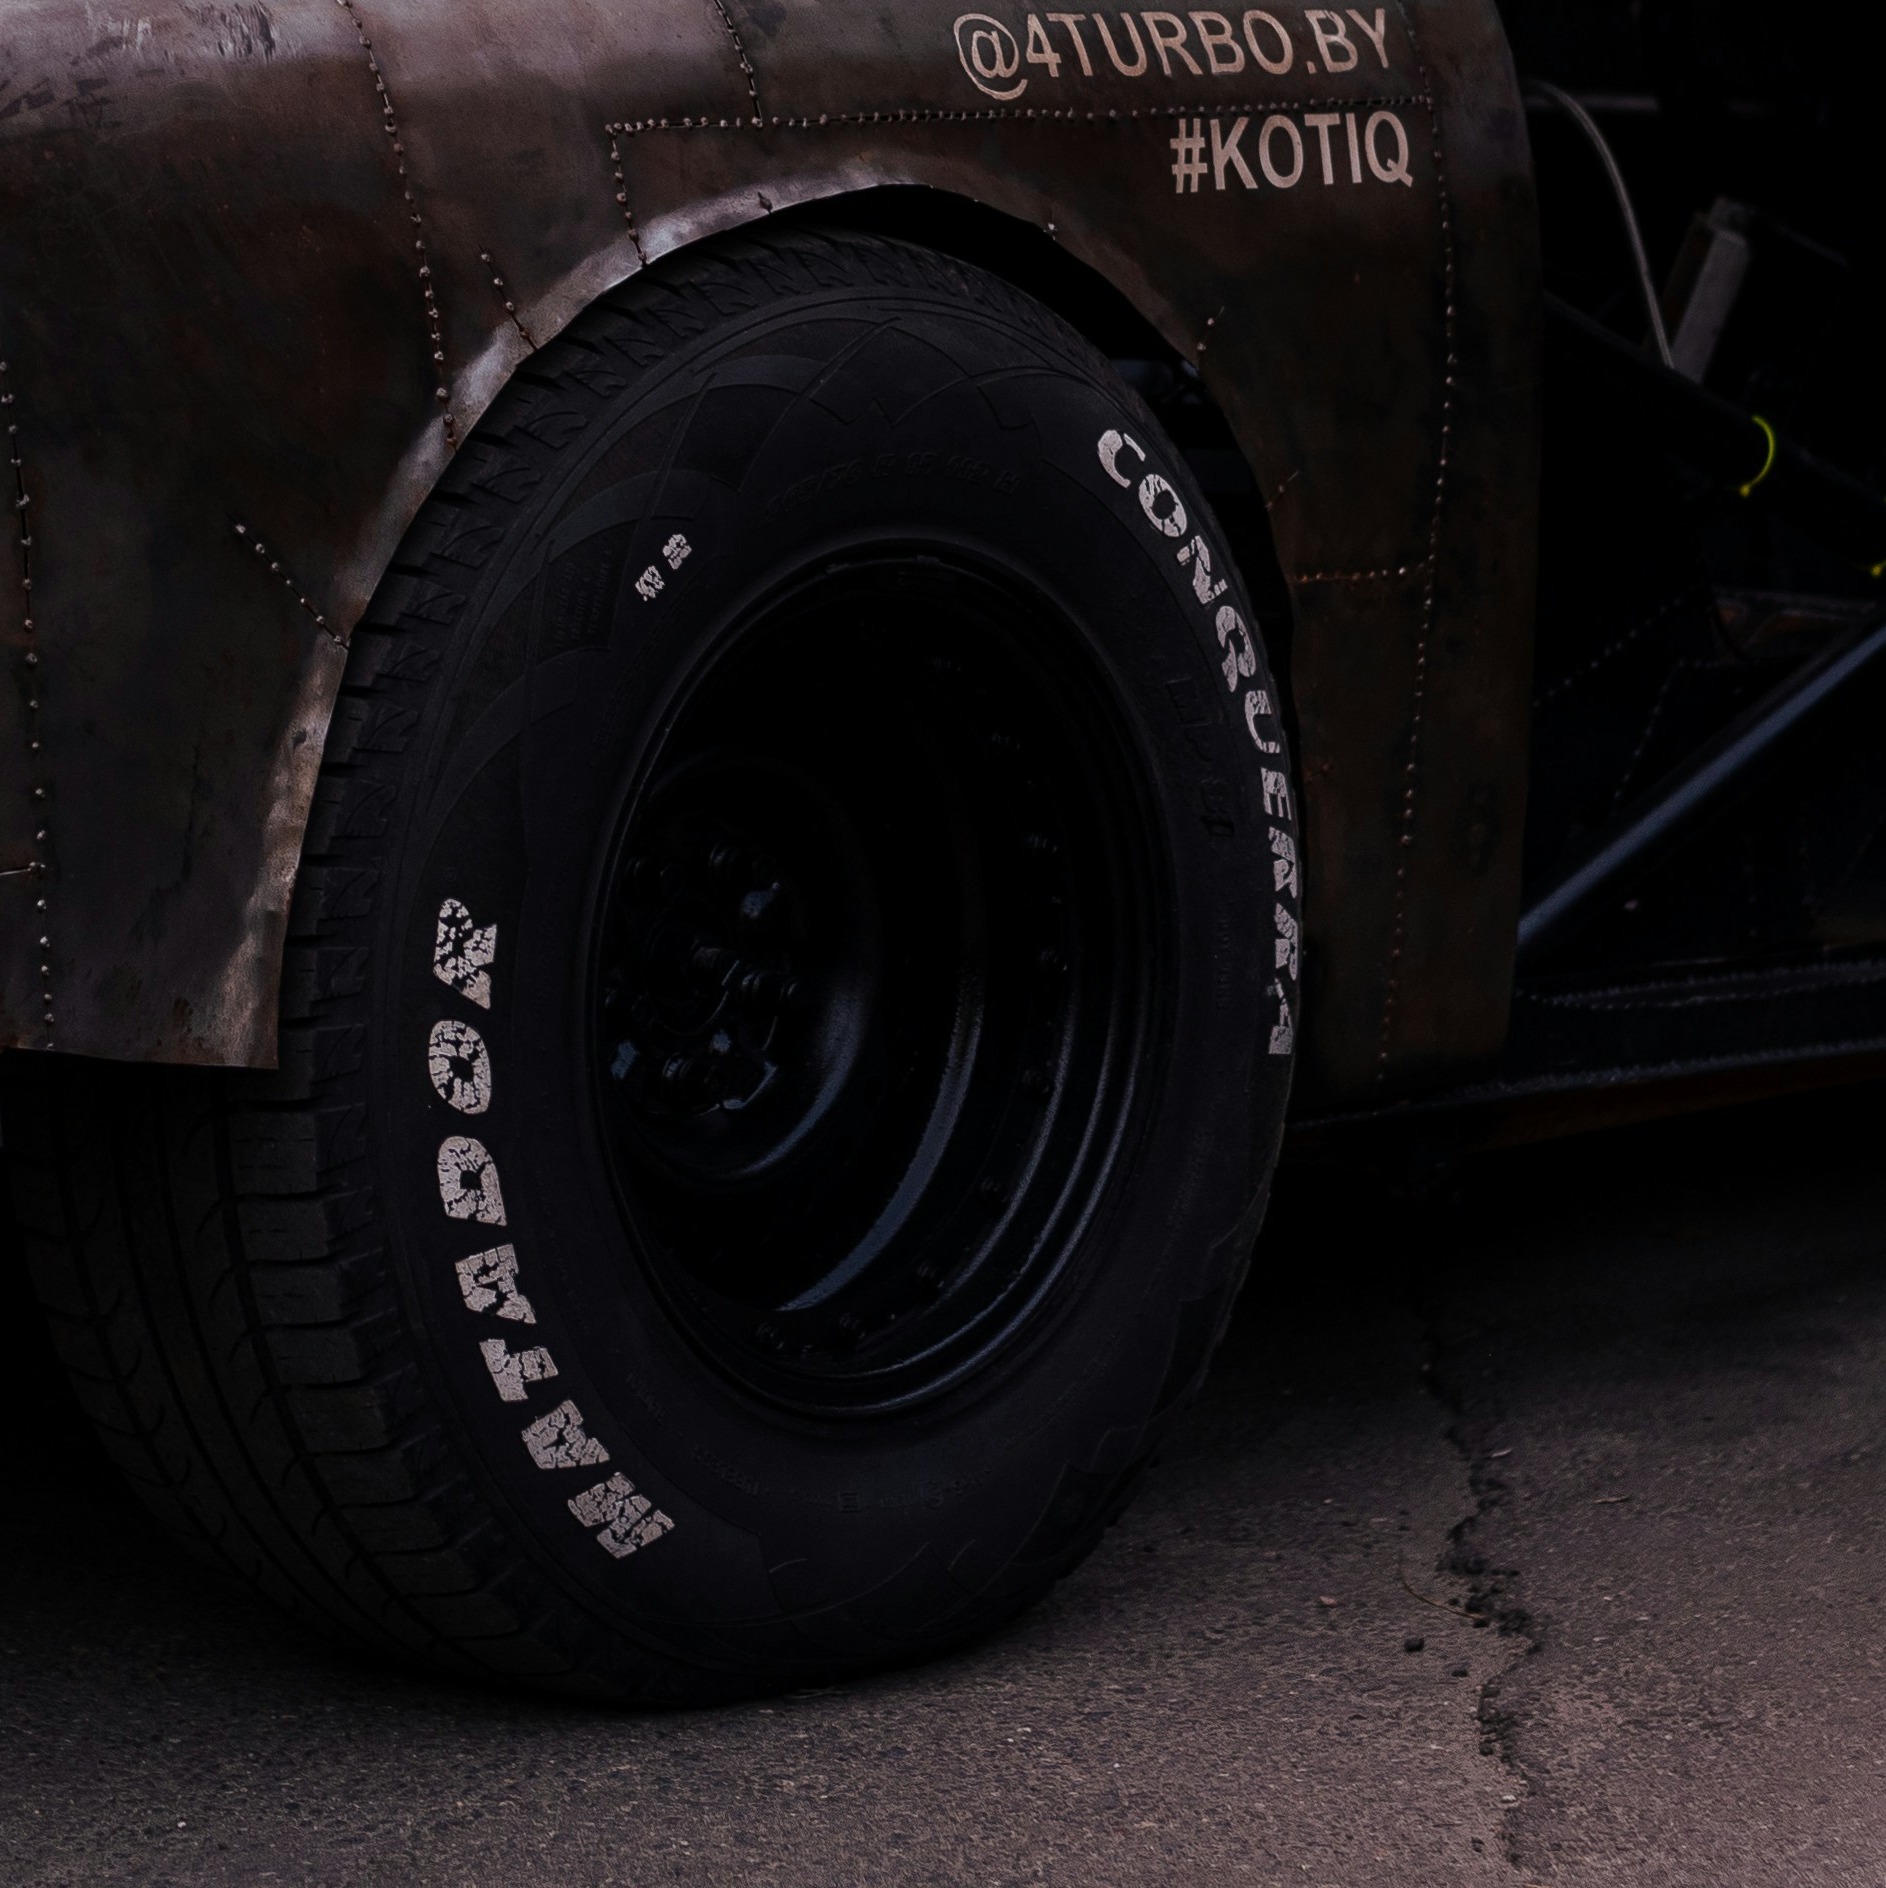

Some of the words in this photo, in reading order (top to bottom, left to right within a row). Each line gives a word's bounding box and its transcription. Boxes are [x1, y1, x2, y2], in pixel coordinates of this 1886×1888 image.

[953, 8, 1390, 101] @4TURBO.BY
[1169, 111, 1413, 194] #KOTIQ
[1097, 429, 1299, 1055] CONQUERRA
[427, 897, 676, 1560] MATADOR
